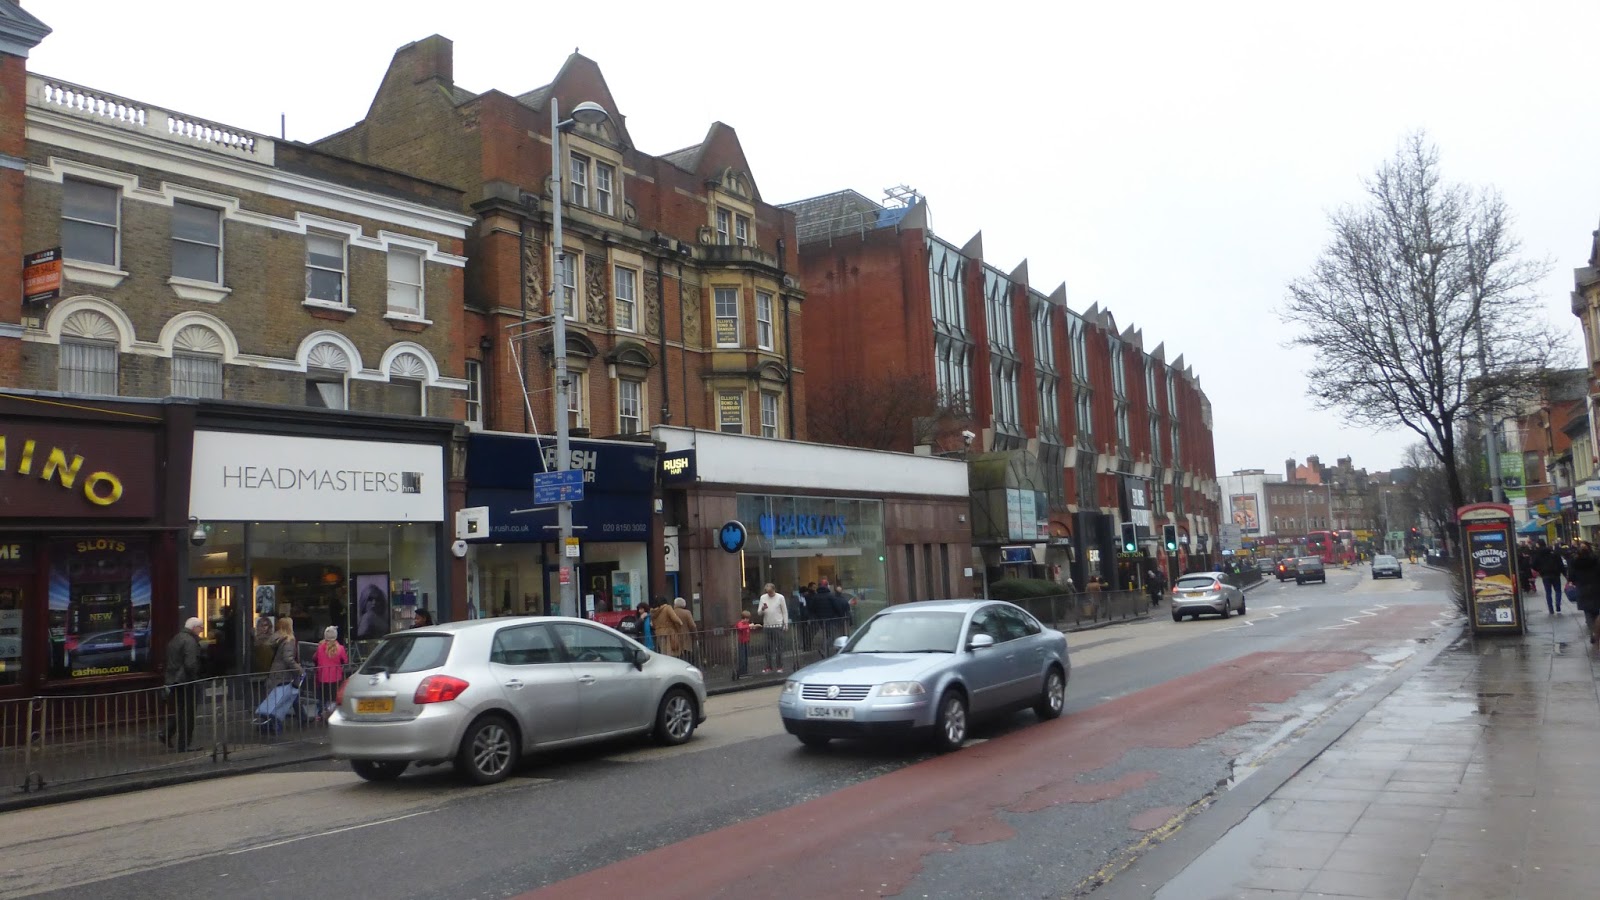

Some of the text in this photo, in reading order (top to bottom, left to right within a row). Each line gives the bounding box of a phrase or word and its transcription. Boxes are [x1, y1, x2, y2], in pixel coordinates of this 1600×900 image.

[544, 448, 597, 470] RSH
[664, 457, 688, 470] RUSH
[223, 465, 399, 492] HEADMASTERS
[402, 485, 415, 493] hm
[603, 524, 615, 532] 020
[778, 513, 847, 537] BARCLAYS
[77, 539, 126, 552] SLOTS
[1472, 549, 1508, 559] CHRISTMAS
[89, 612, 112, 621] NEW
[72, 666, 129, 677] cashino.com
